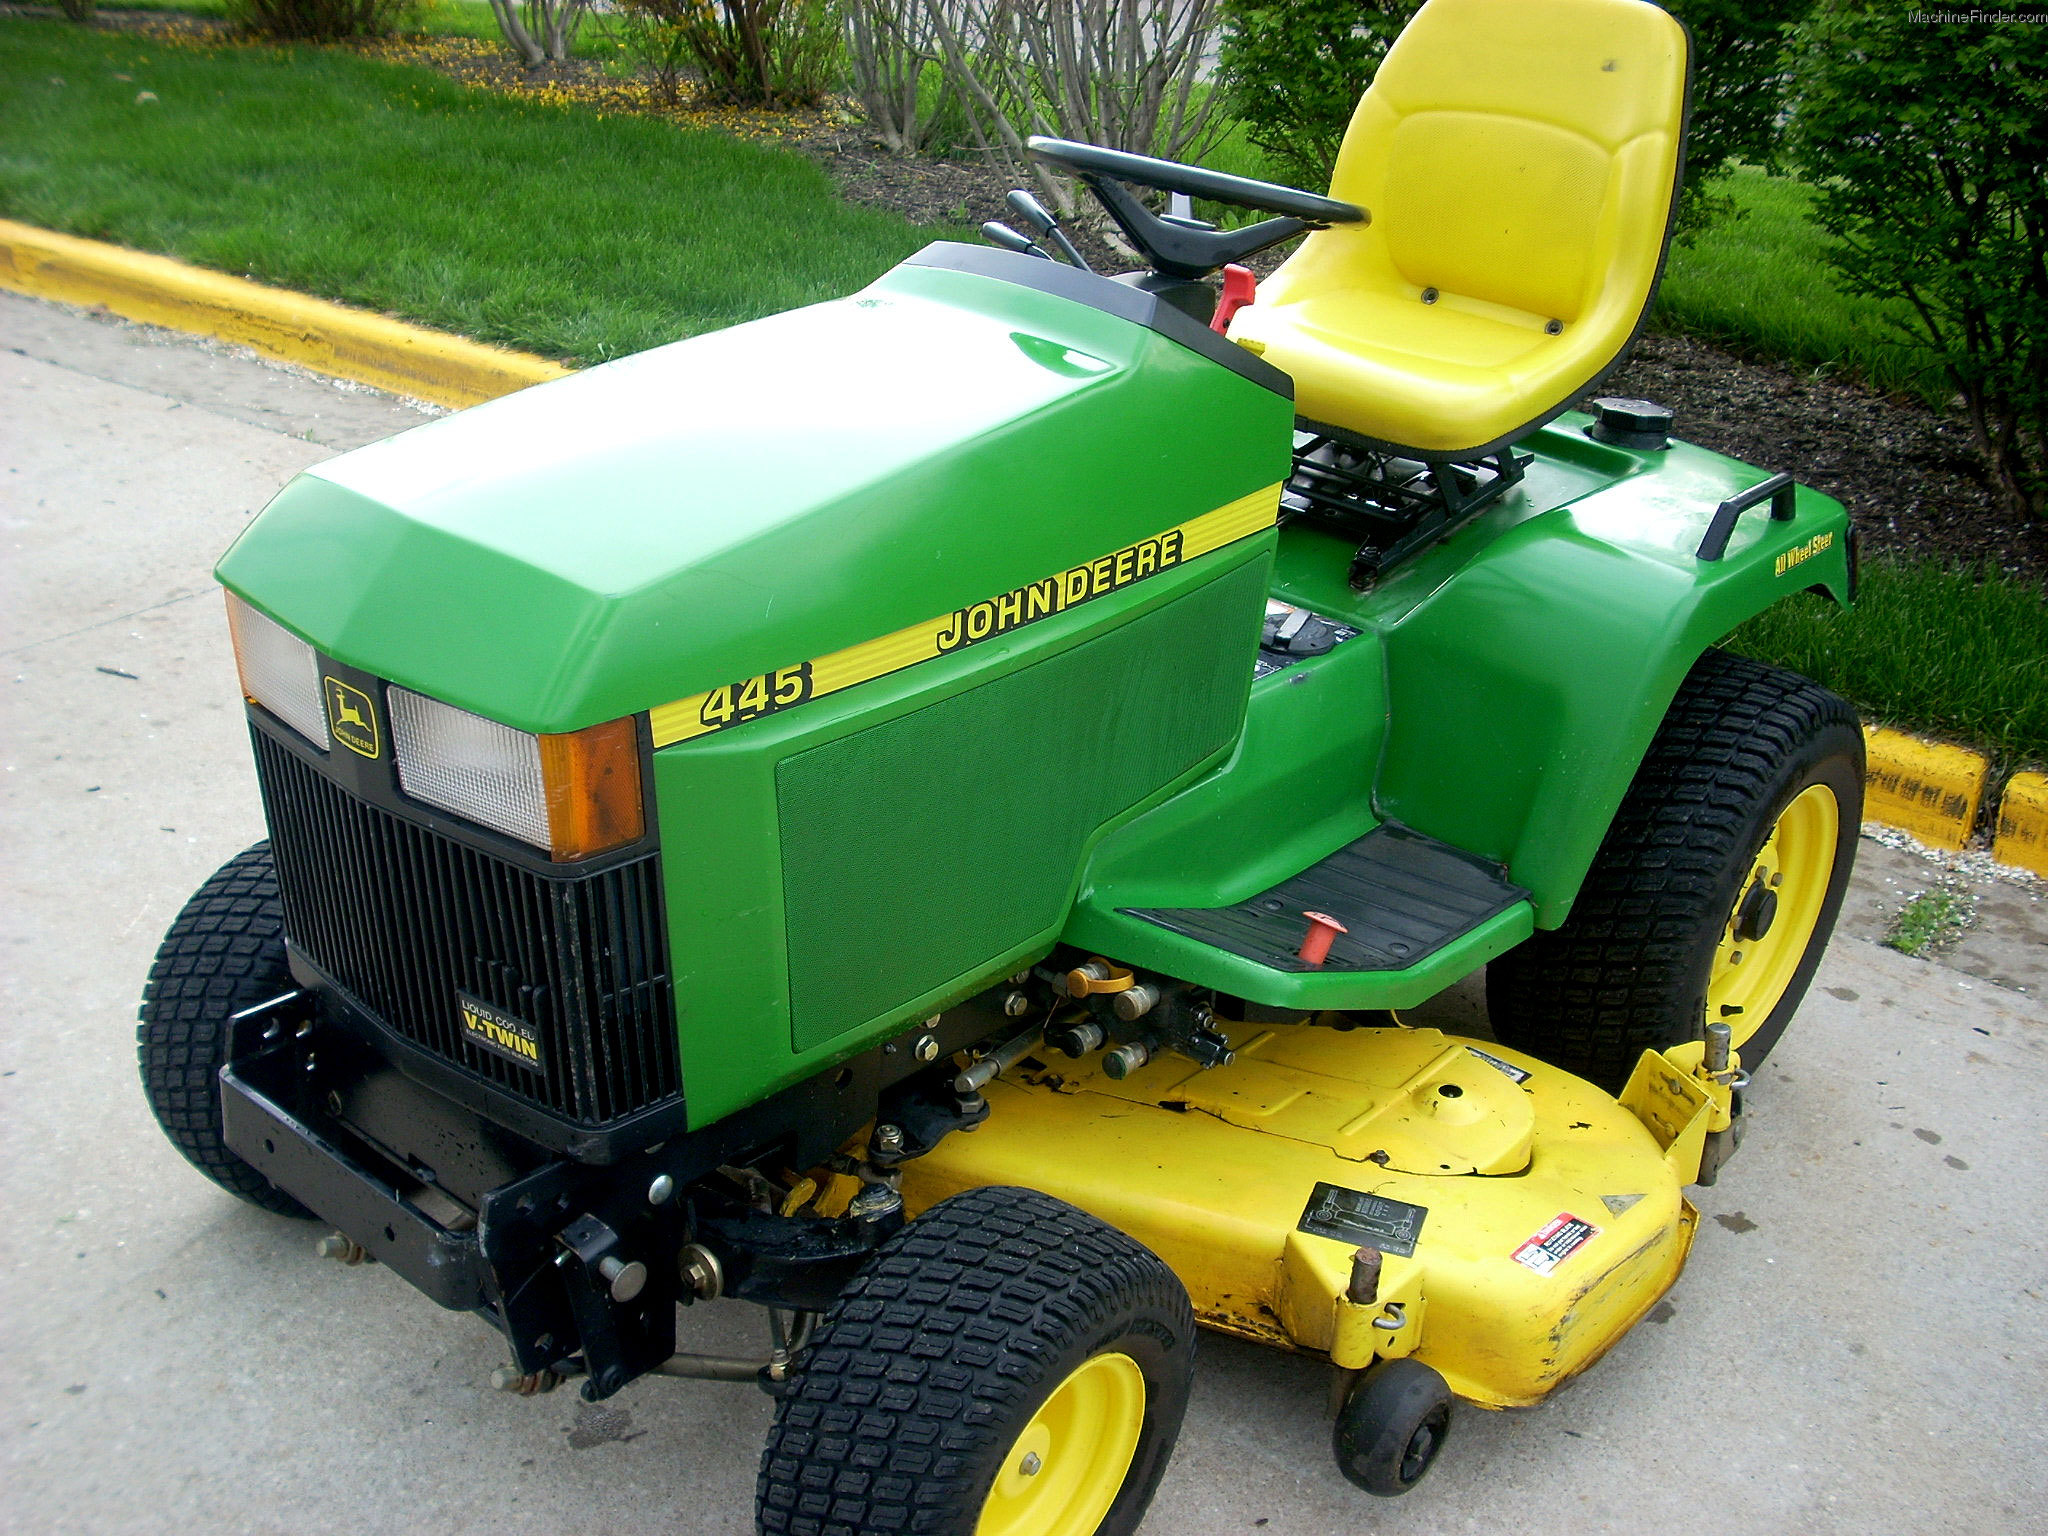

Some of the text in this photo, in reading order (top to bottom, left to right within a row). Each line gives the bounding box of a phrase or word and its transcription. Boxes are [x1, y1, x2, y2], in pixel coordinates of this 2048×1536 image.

[1775, 531, 1833, 577] All Wheel Steer
[937, 530, 1184, 654] JOHN DEERE
[701, 662, 810, 725] 445
[351, 735, 375, 752] DEERE
[462, 999, 492, 1021] LIQUID
[463, 1010, 537, 1060] V-TWIN
